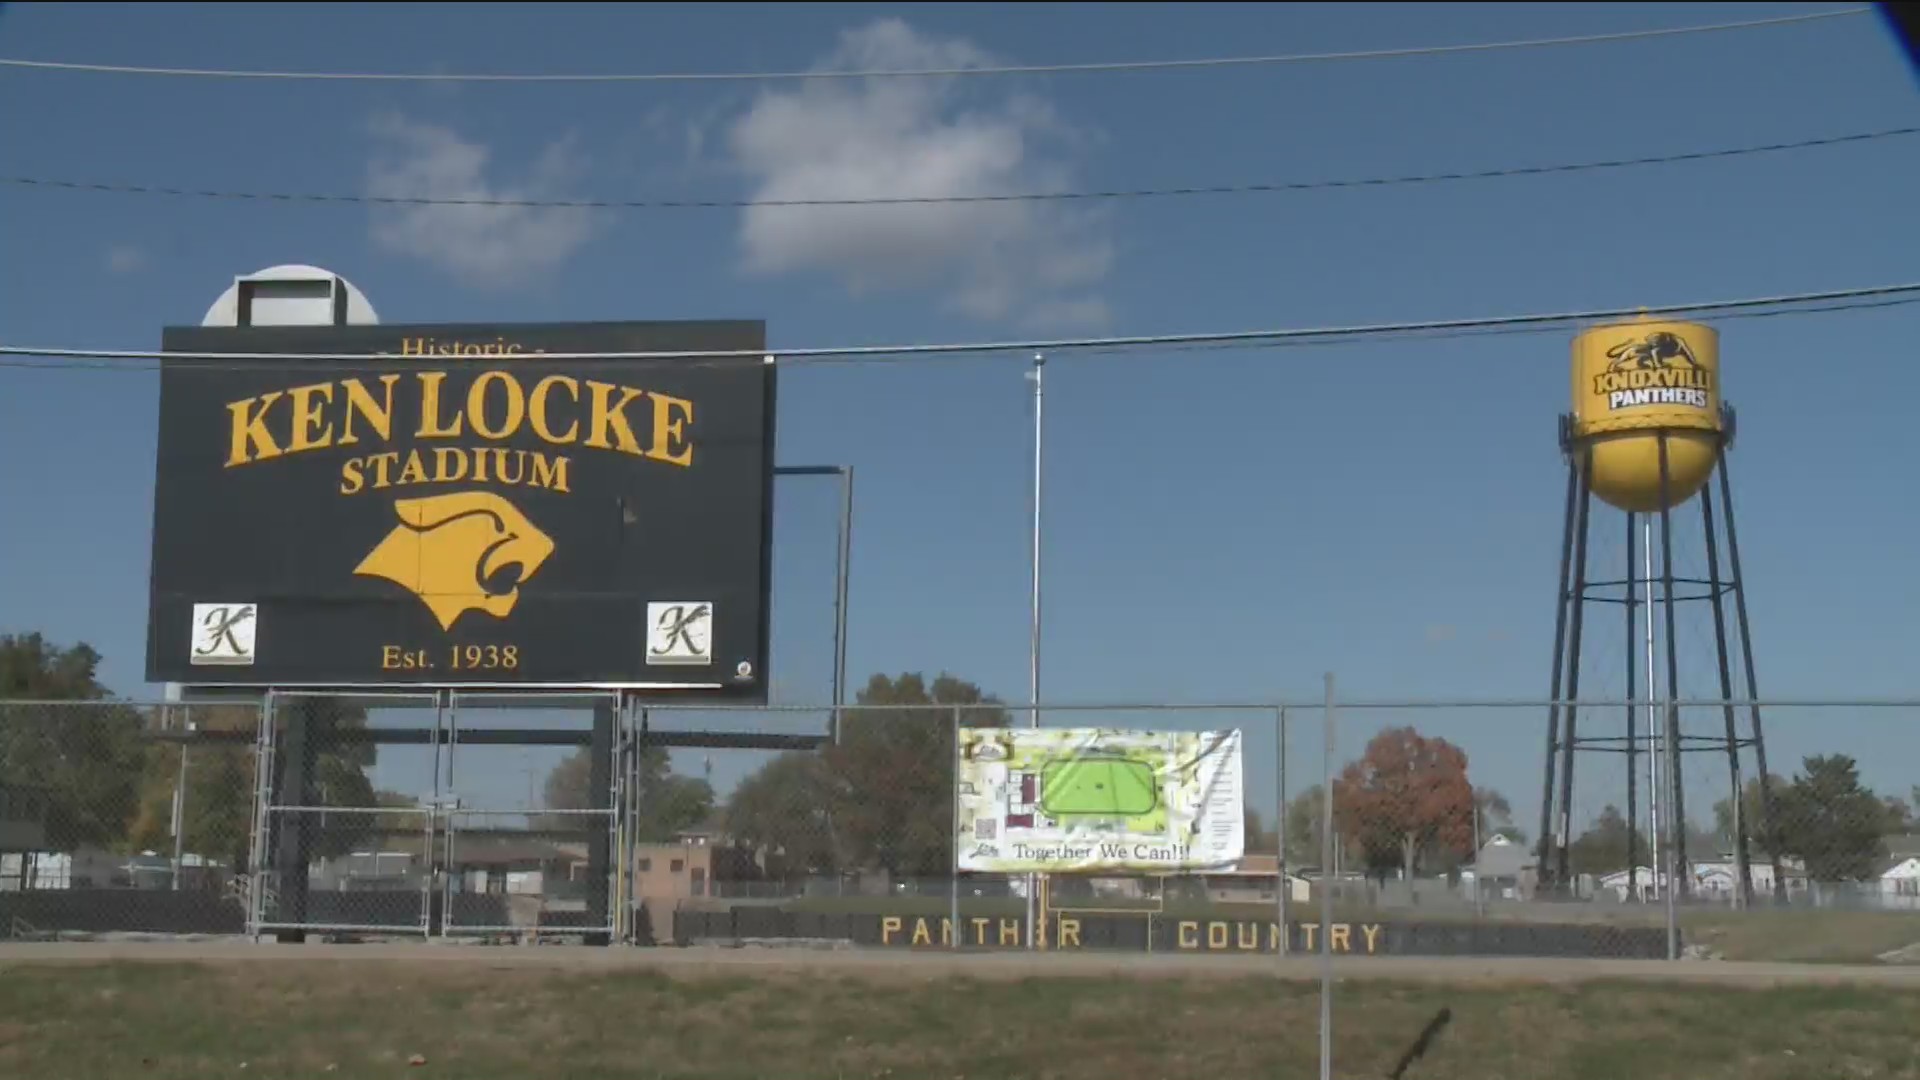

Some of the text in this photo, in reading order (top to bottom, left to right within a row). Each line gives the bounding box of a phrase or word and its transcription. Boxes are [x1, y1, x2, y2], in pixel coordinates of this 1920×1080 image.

[402, 336, 522, 357] Historic
[1609, 387, 1706, 410] PANTHERS
[223, 370, 694, 468] KEN LOCKE
[340, 446, 571, 495] STADIUM
[382, 644, 518, 669] Est. 1938
[1012, 843, 1092, 862] Together
[1100, 844, 1128, 859] We
[1178, 921, 1380, 952] COUNTRY
